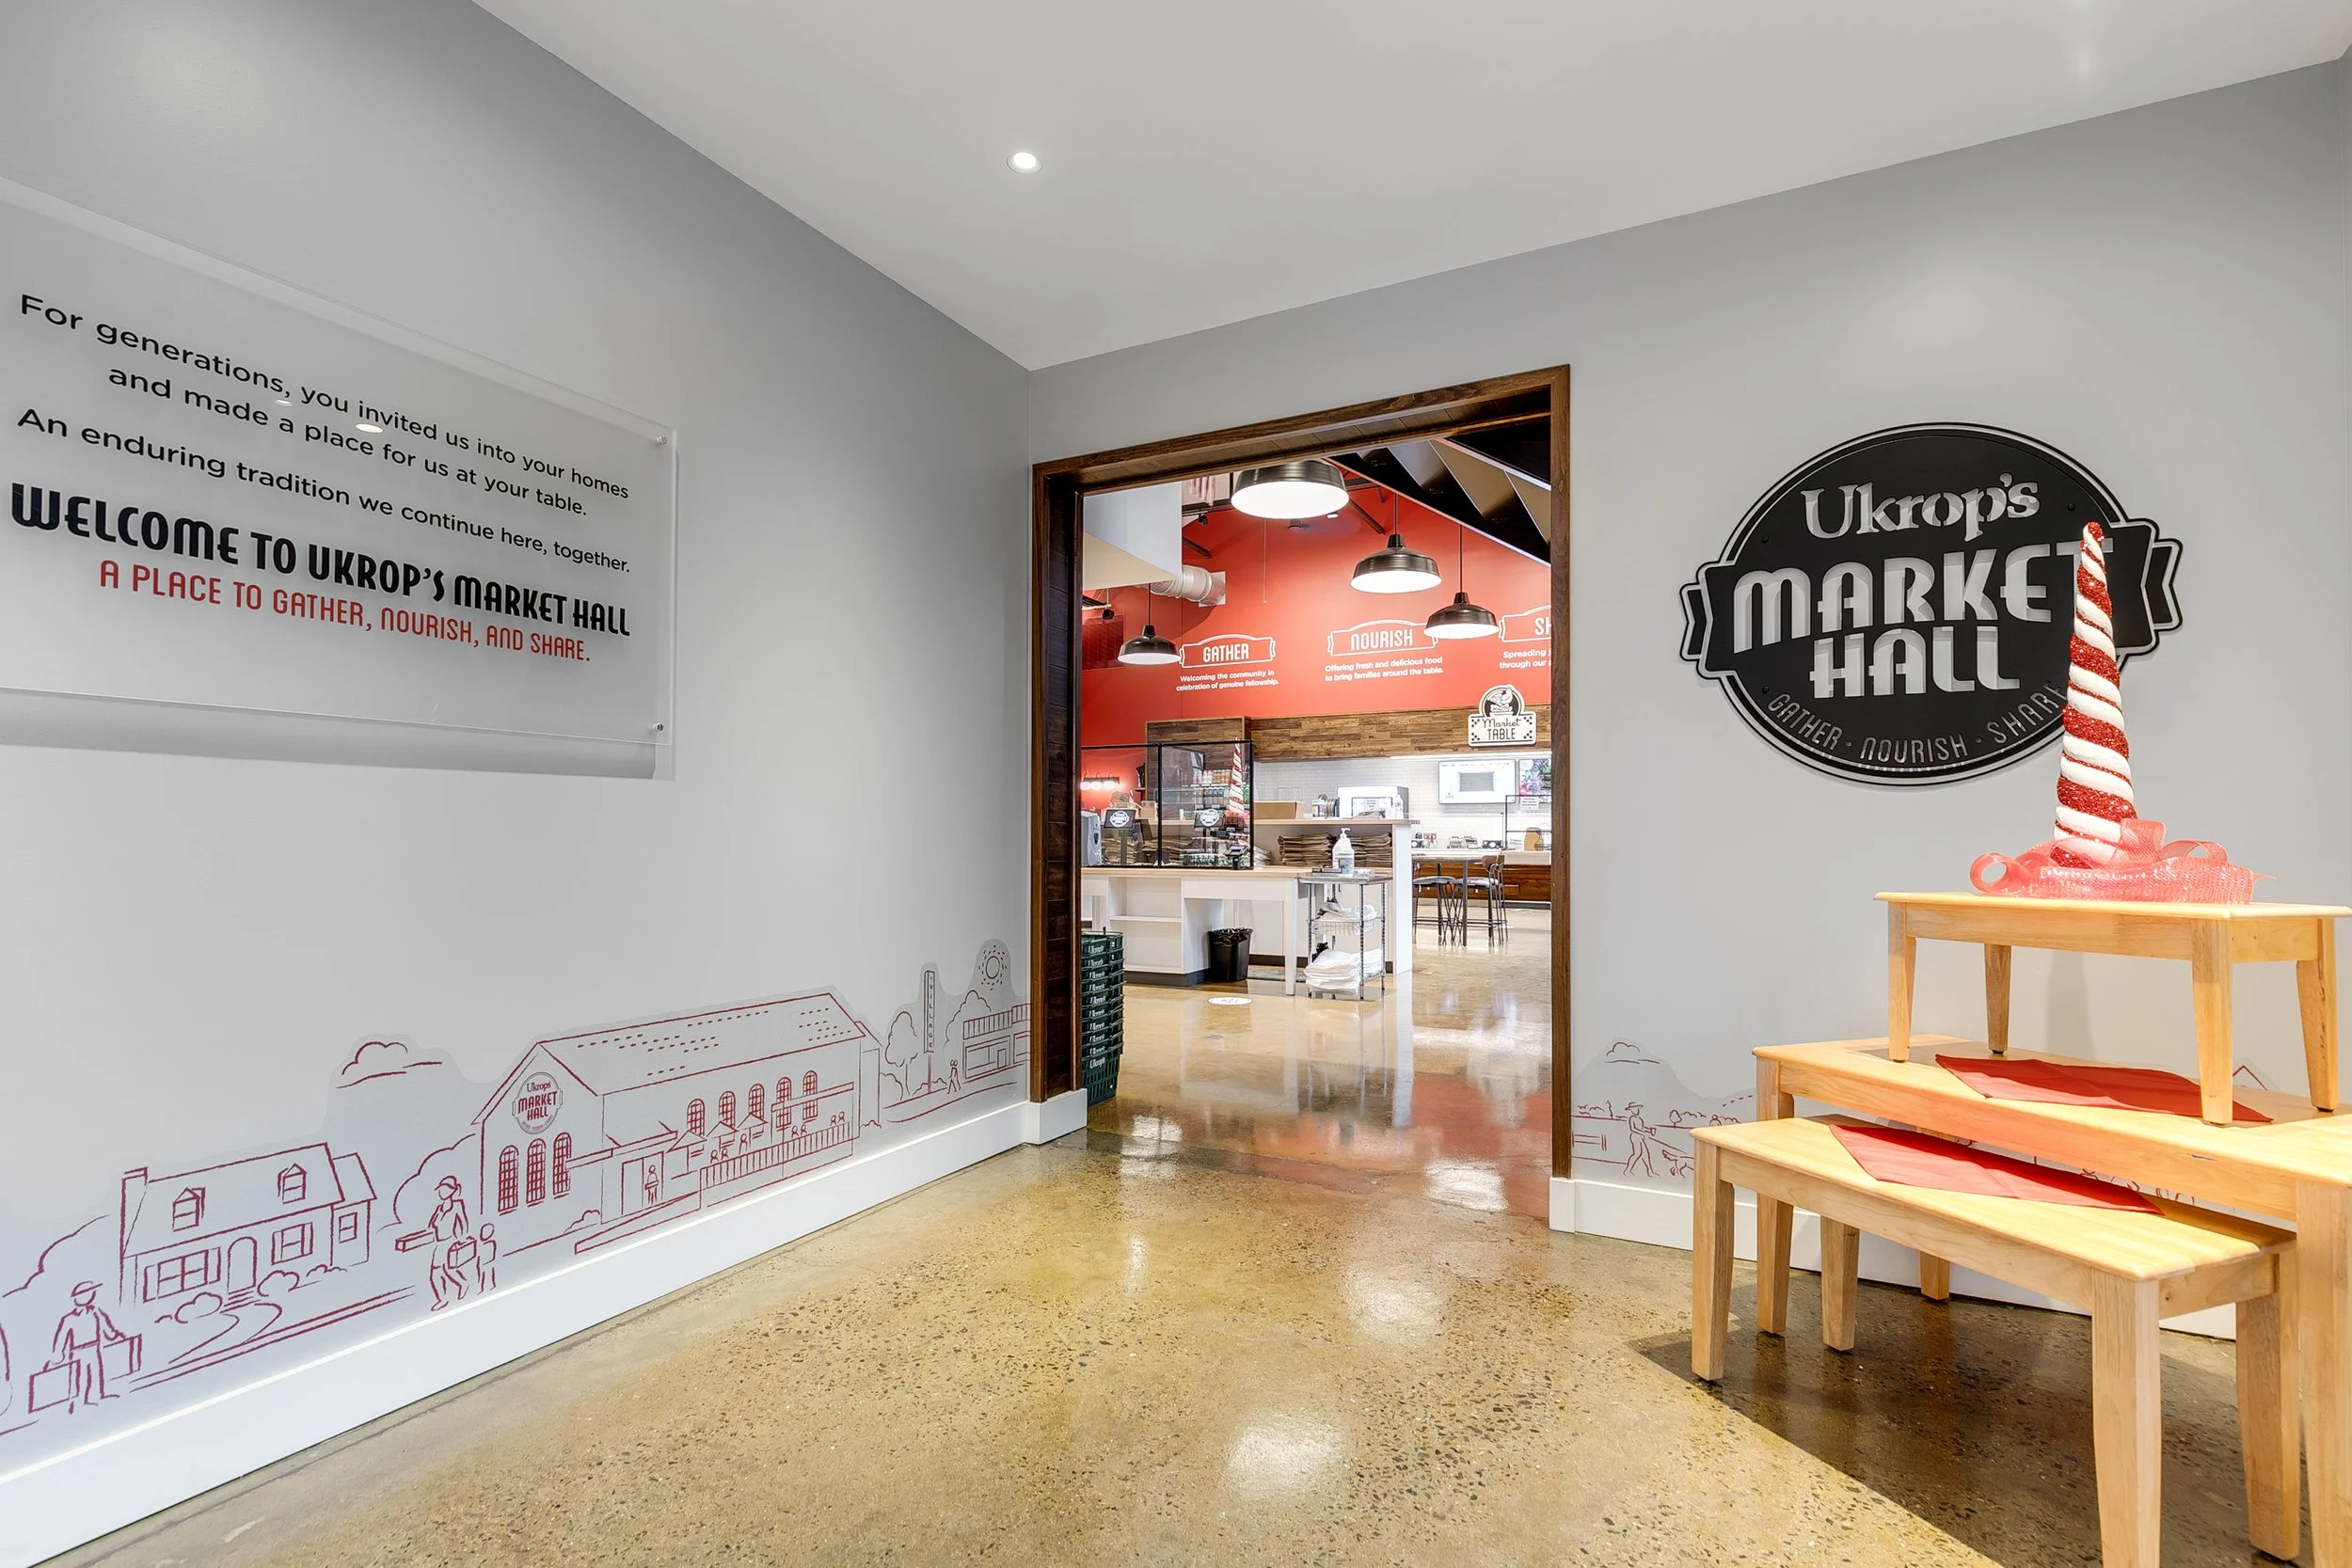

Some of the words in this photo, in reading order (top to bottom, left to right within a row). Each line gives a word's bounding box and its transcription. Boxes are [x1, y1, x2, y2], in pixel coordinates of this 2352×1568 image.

[22, 294, 83, 329] For
[97, 324, 290, 398] generations,
[301, 387, 348, 413] you
[359, 401, 437, 440] invited
[446, 433, 469, 450] us
[478, 442, 516, 463] into
[523, 456, 564, 478] your
[572, 467, 628, 499] homes
[109, 370, 170, 399] and
[185, 390, 268, 425] made
[279, 419, 294, 433] a
[306, 425, 373, 455] place
[383, 444, 416, 467] for
[425, 459, 448, 476] us
[456, 469, 477, 484] at
[485, 477, 529, 499] your
[536, 489, 586, 515] table.
[18, 409, 67, 437] An
[81, 428, 225, 478] enduring
[236, 463, 349, 505] tradition
[359, 496, 392, 515] we
[402, 507, 494, 539] continue
[501, 527, 547, 555] here,
[554, 542, 629, 572] together.
[1802, 473, 2040, 541] Ukrop's
[11, 483, 239, 564] WELCOME
[250, 531, 296, 574] TO
[309, 544, 444, 602] UKROP'S
[454, 575, 567, 624] MARKET
[573, 598, 629, 636] HALL
[101, 561, 119, 589] A
[133, 564, 220, 604] PLACE
[233, 581, 262, 610] TO
[274, 589, 372, 631] GATHER,
[381, 608, 478, 647] NOURISH,
[486, 626, 523, 650] AND
[531, 633, 590, 661] SHARE.
[1351, 628, 1413, 650] NOURISH
[1203, 642, 1249, 663] GATHER
[1503, 649, 1546, 659] Spreading
[1809, 626, 2021, 698] HALL
[1325, 663, 1354, 673] Offering
[1356, 661, 1374, 670] fresh
[1391, 658, 1423, 667] delicious
[1334, 673, 1353, 681] bring
[1354, 671, 1381, 679] families
[1382, 669, 1408, 677] around
[1500, 660, 1531, 669] through
[1176, 682, 1211, 691] celebration
[1219, 680, 1244, 689] genuine
[1245, 678, 1279, 687] fellowship.
[1180, 673, 1216, 682] Welcoming
[1230, 670, 1266, 678] community
[1482, 718, 1521, 728] Market
[1768, 693, 1843, 751] GATHER
[1860, 733, 1968, 763] NOURISH
[1487, 728, 1516, 740] TABLE
[518, 1091, 558, 1114] MARKET
[527, 1106, 548, 1120] HALL
